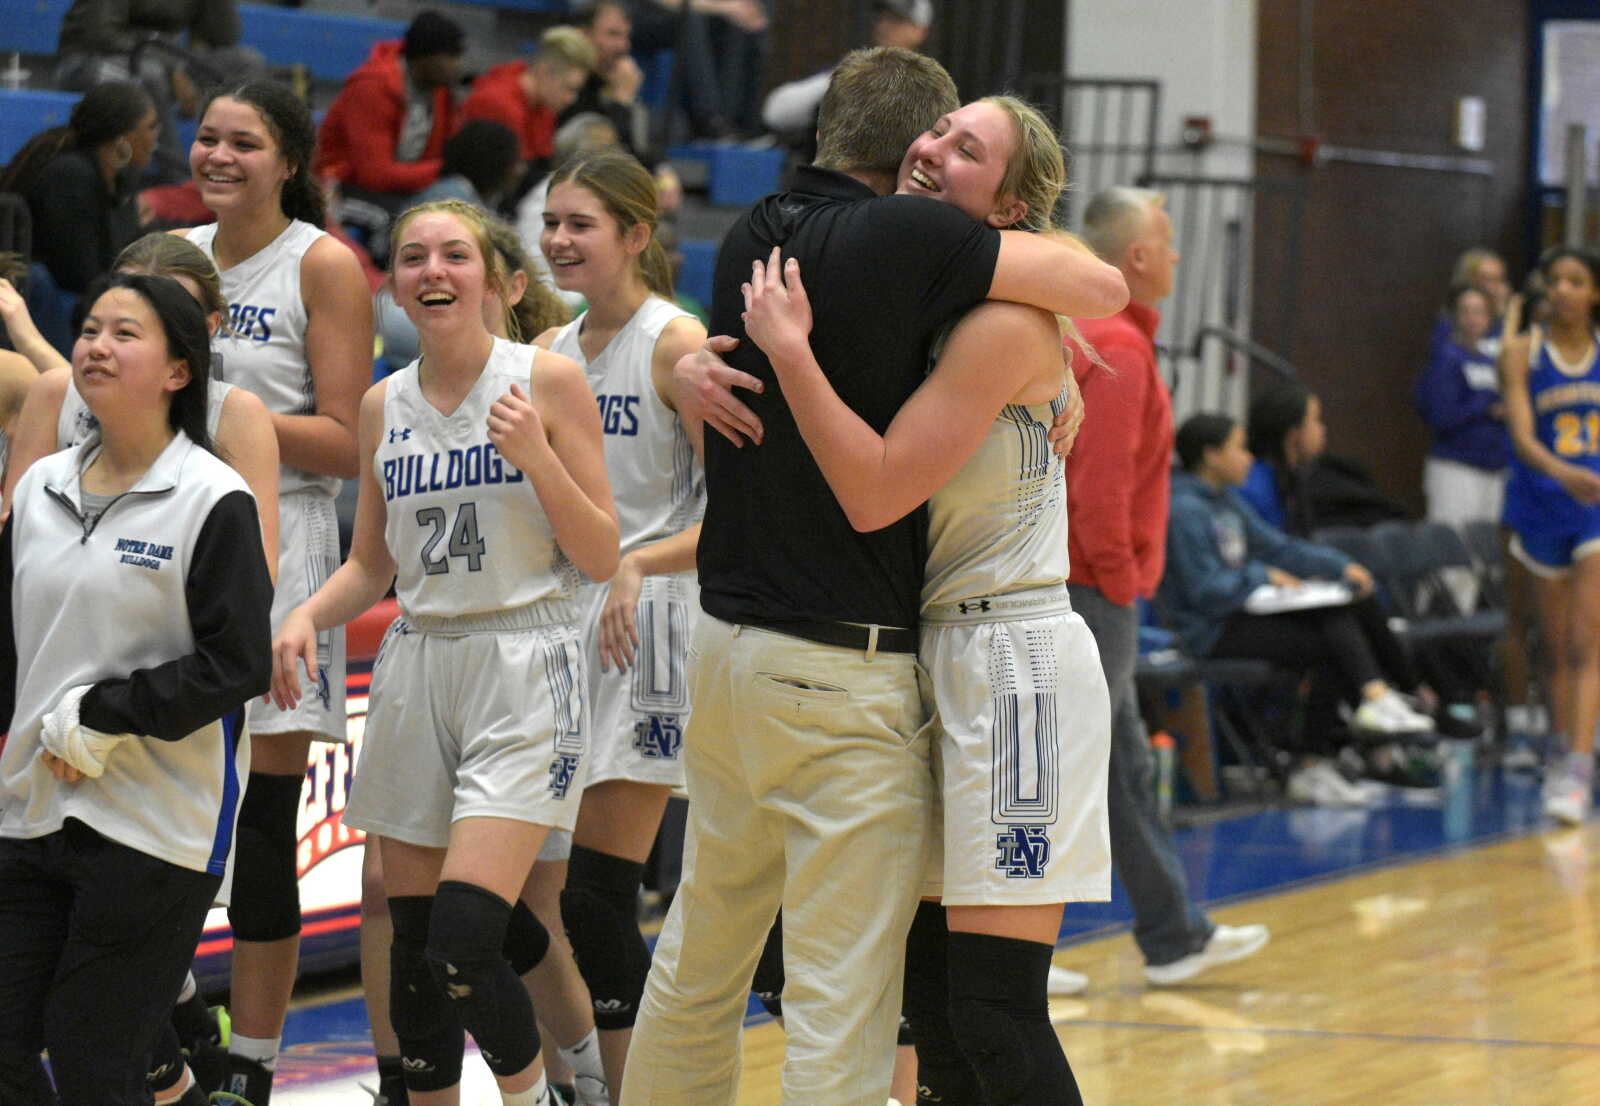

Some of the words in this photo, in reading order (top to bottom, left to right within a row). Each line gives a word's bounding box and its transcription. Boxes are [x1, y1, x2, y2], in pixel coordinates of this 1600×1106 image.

[1554, 411, 1600, 456] 21
[114, 537, 148, 554] NOTRE
[147, 543, 175, 560] DAME
[415, 501, 486, 576] 24
[119, 554, 161, 570] BULLDOGS
